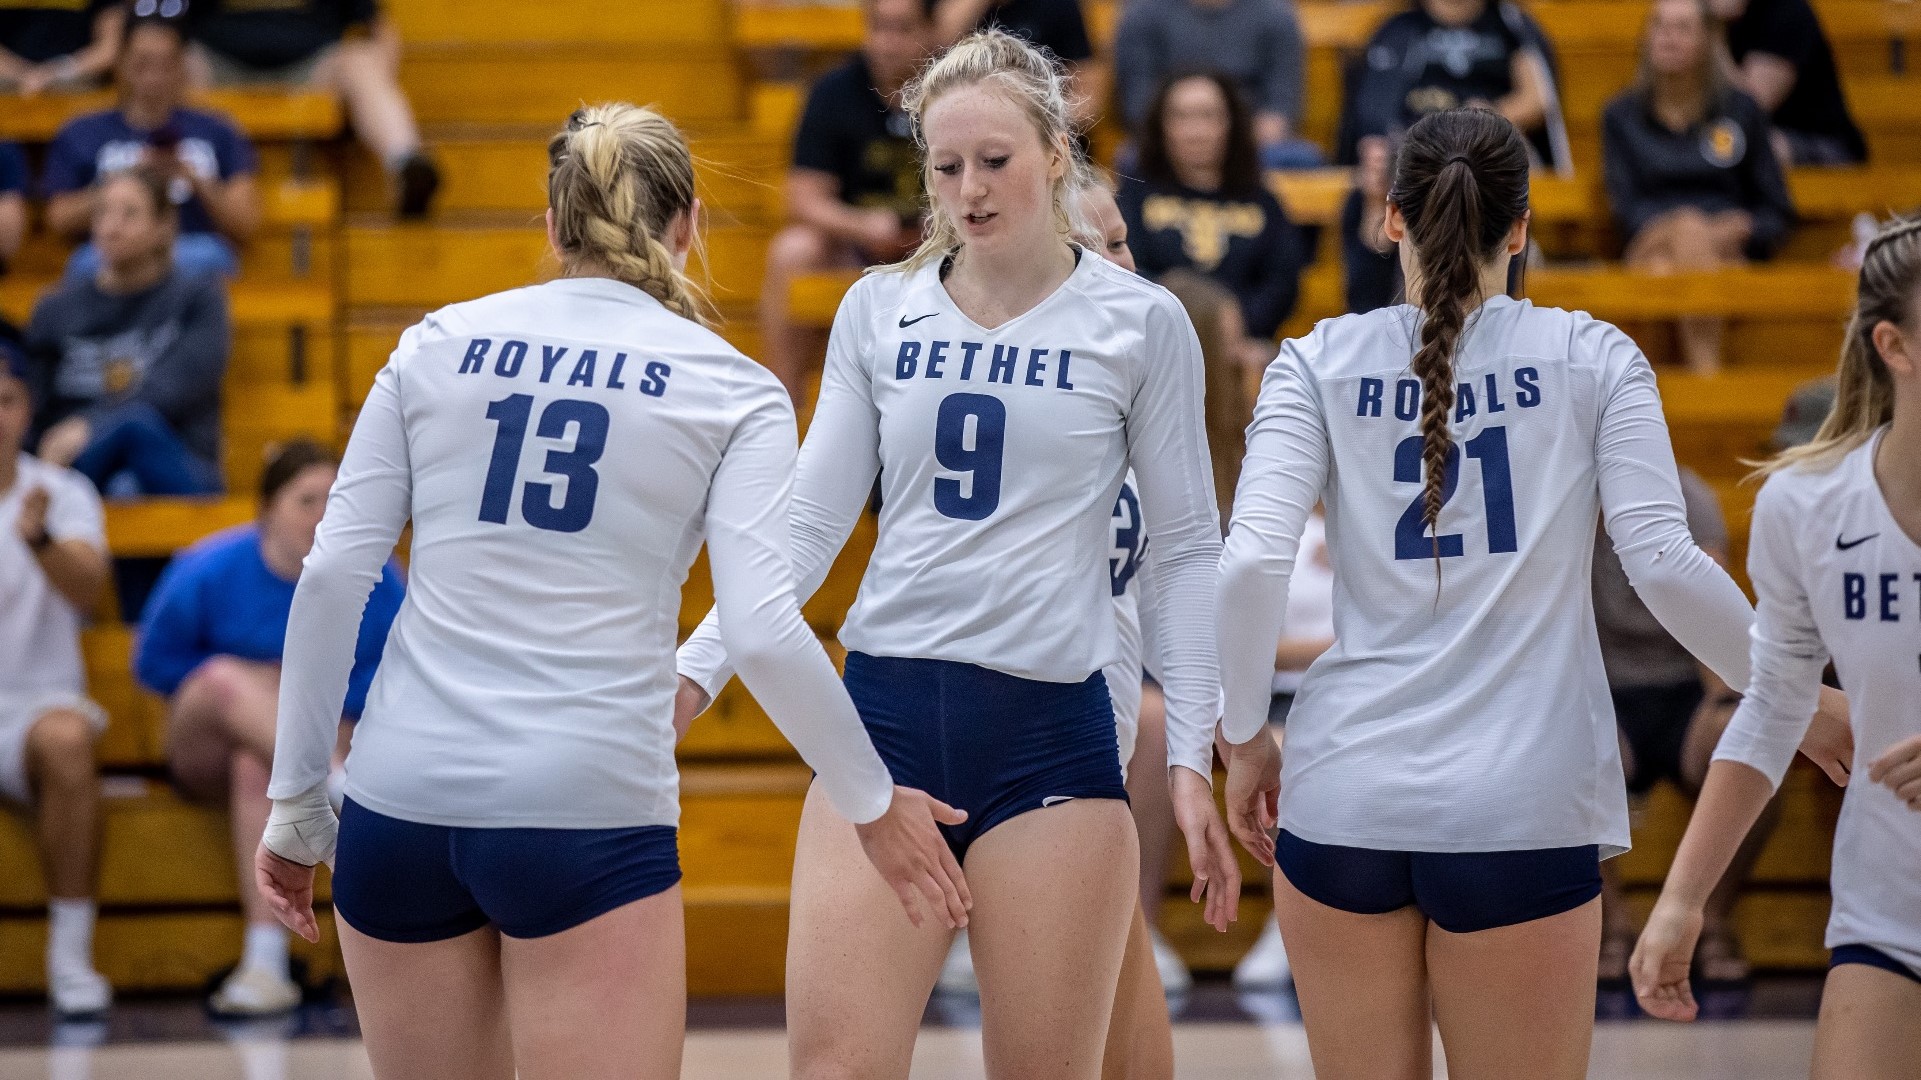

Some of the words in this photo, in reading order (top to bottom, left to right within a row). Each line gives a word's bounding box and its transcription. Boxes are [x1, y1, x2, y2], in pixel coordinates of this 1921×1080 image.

[458, 338, 671, 397] ROYALS
[896, 340, 1074, 390] BETHEL
[1356, 367, 1541, 424] ROALS
[478, 393, 610, 533] 13
[933, 392, 1006, 521] 9
[1393, 425, 1518, 560] 21
[1109, 483, 1150, 597] 3
